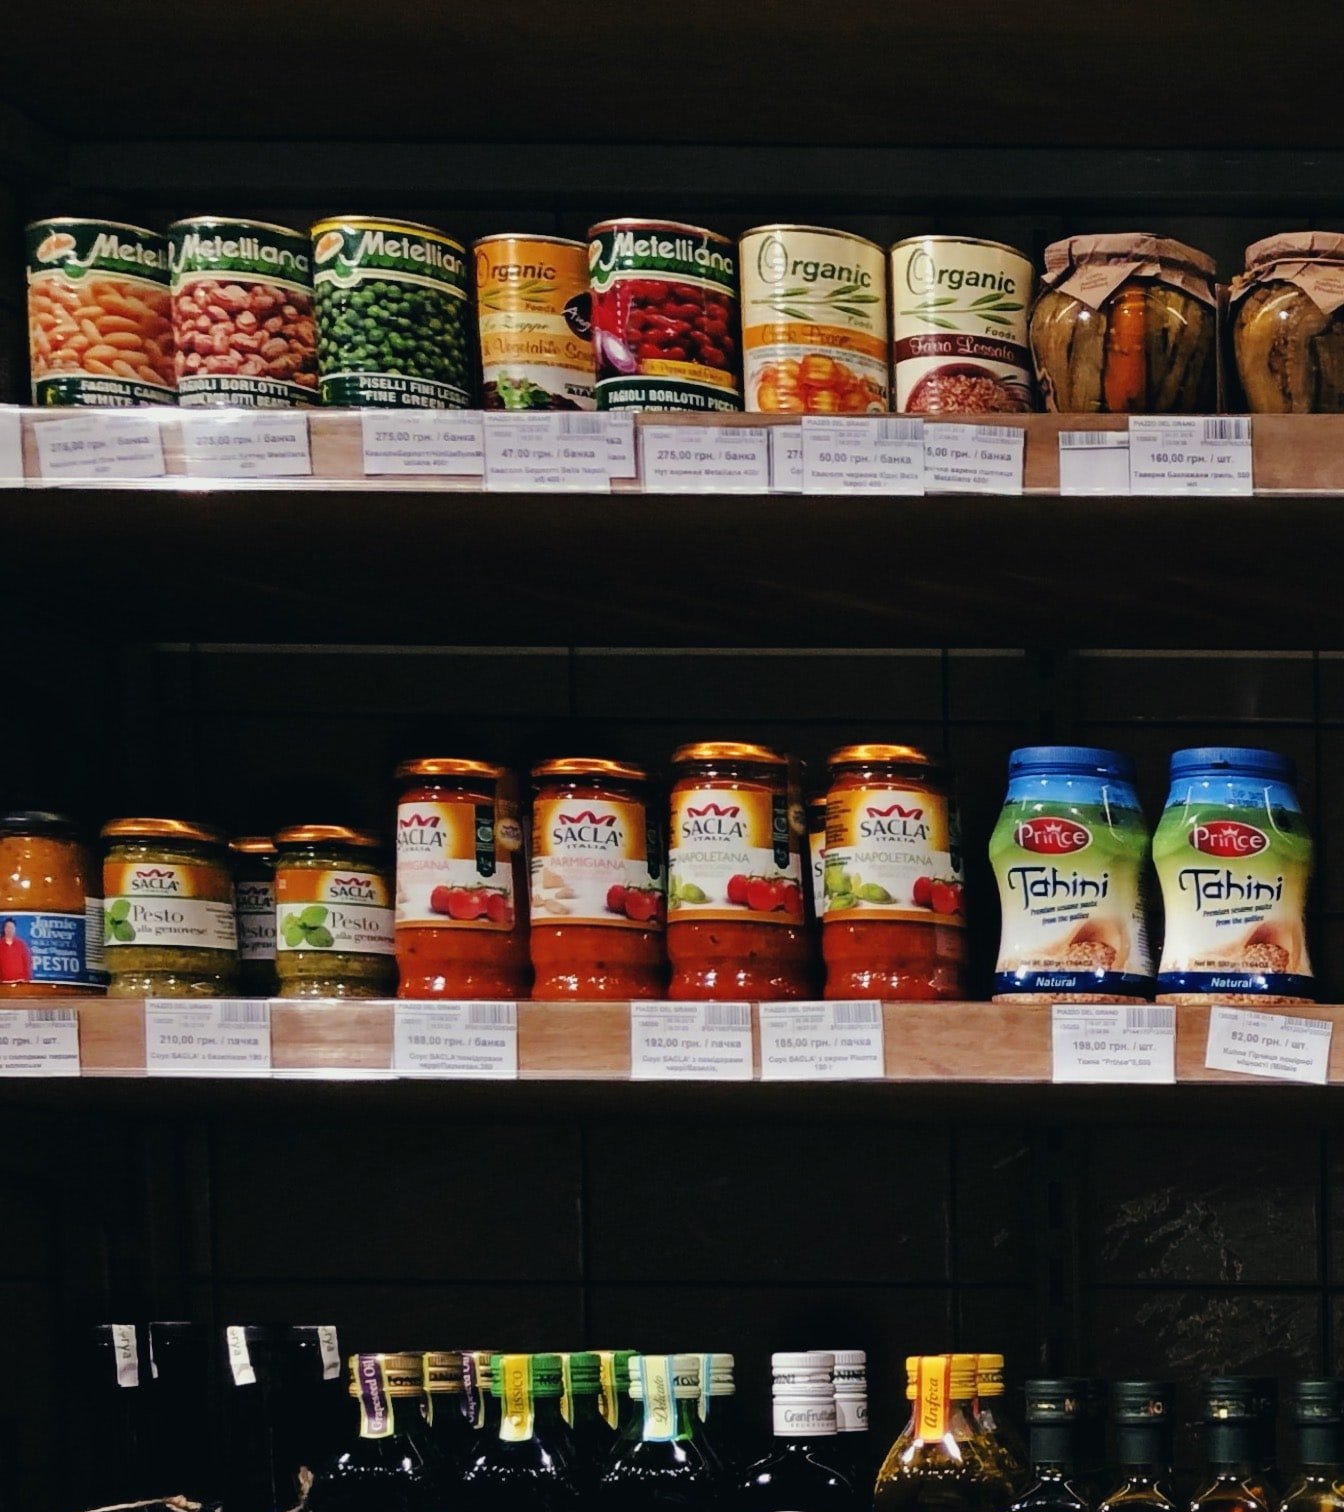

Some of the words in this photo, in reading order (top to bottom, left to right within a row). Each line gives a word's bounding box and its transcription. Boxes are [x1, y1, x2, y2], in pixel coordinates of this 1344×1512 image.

[170, 233, 309, 273] Metelliana
[603, 230, 733, 275] Metelliana
[758, 236, 871, 289] Organic
[908, 247, 1015, 296] Organic
[360, 378, 406, 393] PISELLI
[410, 383, 434, 396] FINI
[608, 388, 648, 405] FAGIOLI
[653, 390, 704, 407] BORLOTTI
[1192, 826, 1267, 849] Prince
[550, 857, 626, 871] PARMIGIANA
[855, 851, 933, 866] NAPOLETANA
[1008, 867, 1110, 910] Tahini
[1179, 869, 1283, 910] Tahini
[31, 916, 75, 930] Jamie
[133, 905, 184, 924] Pesto
[330, 912, 380, 932] Pesto
[31, 928, 74, 941] Oliver
[136, 925, 152, 934] alla
[155, 924, 207, 936] genovese
[33, 957, 80, 973] PESTO
[1211, 977, 1252, 989] Natural
[159, 1036, 192, 1046] 210,00
[197, 1038, 219, 1048] грн.
[645, 1038, 678, 1048] 192,00
[681, 1040, 702, 1050] грн.
